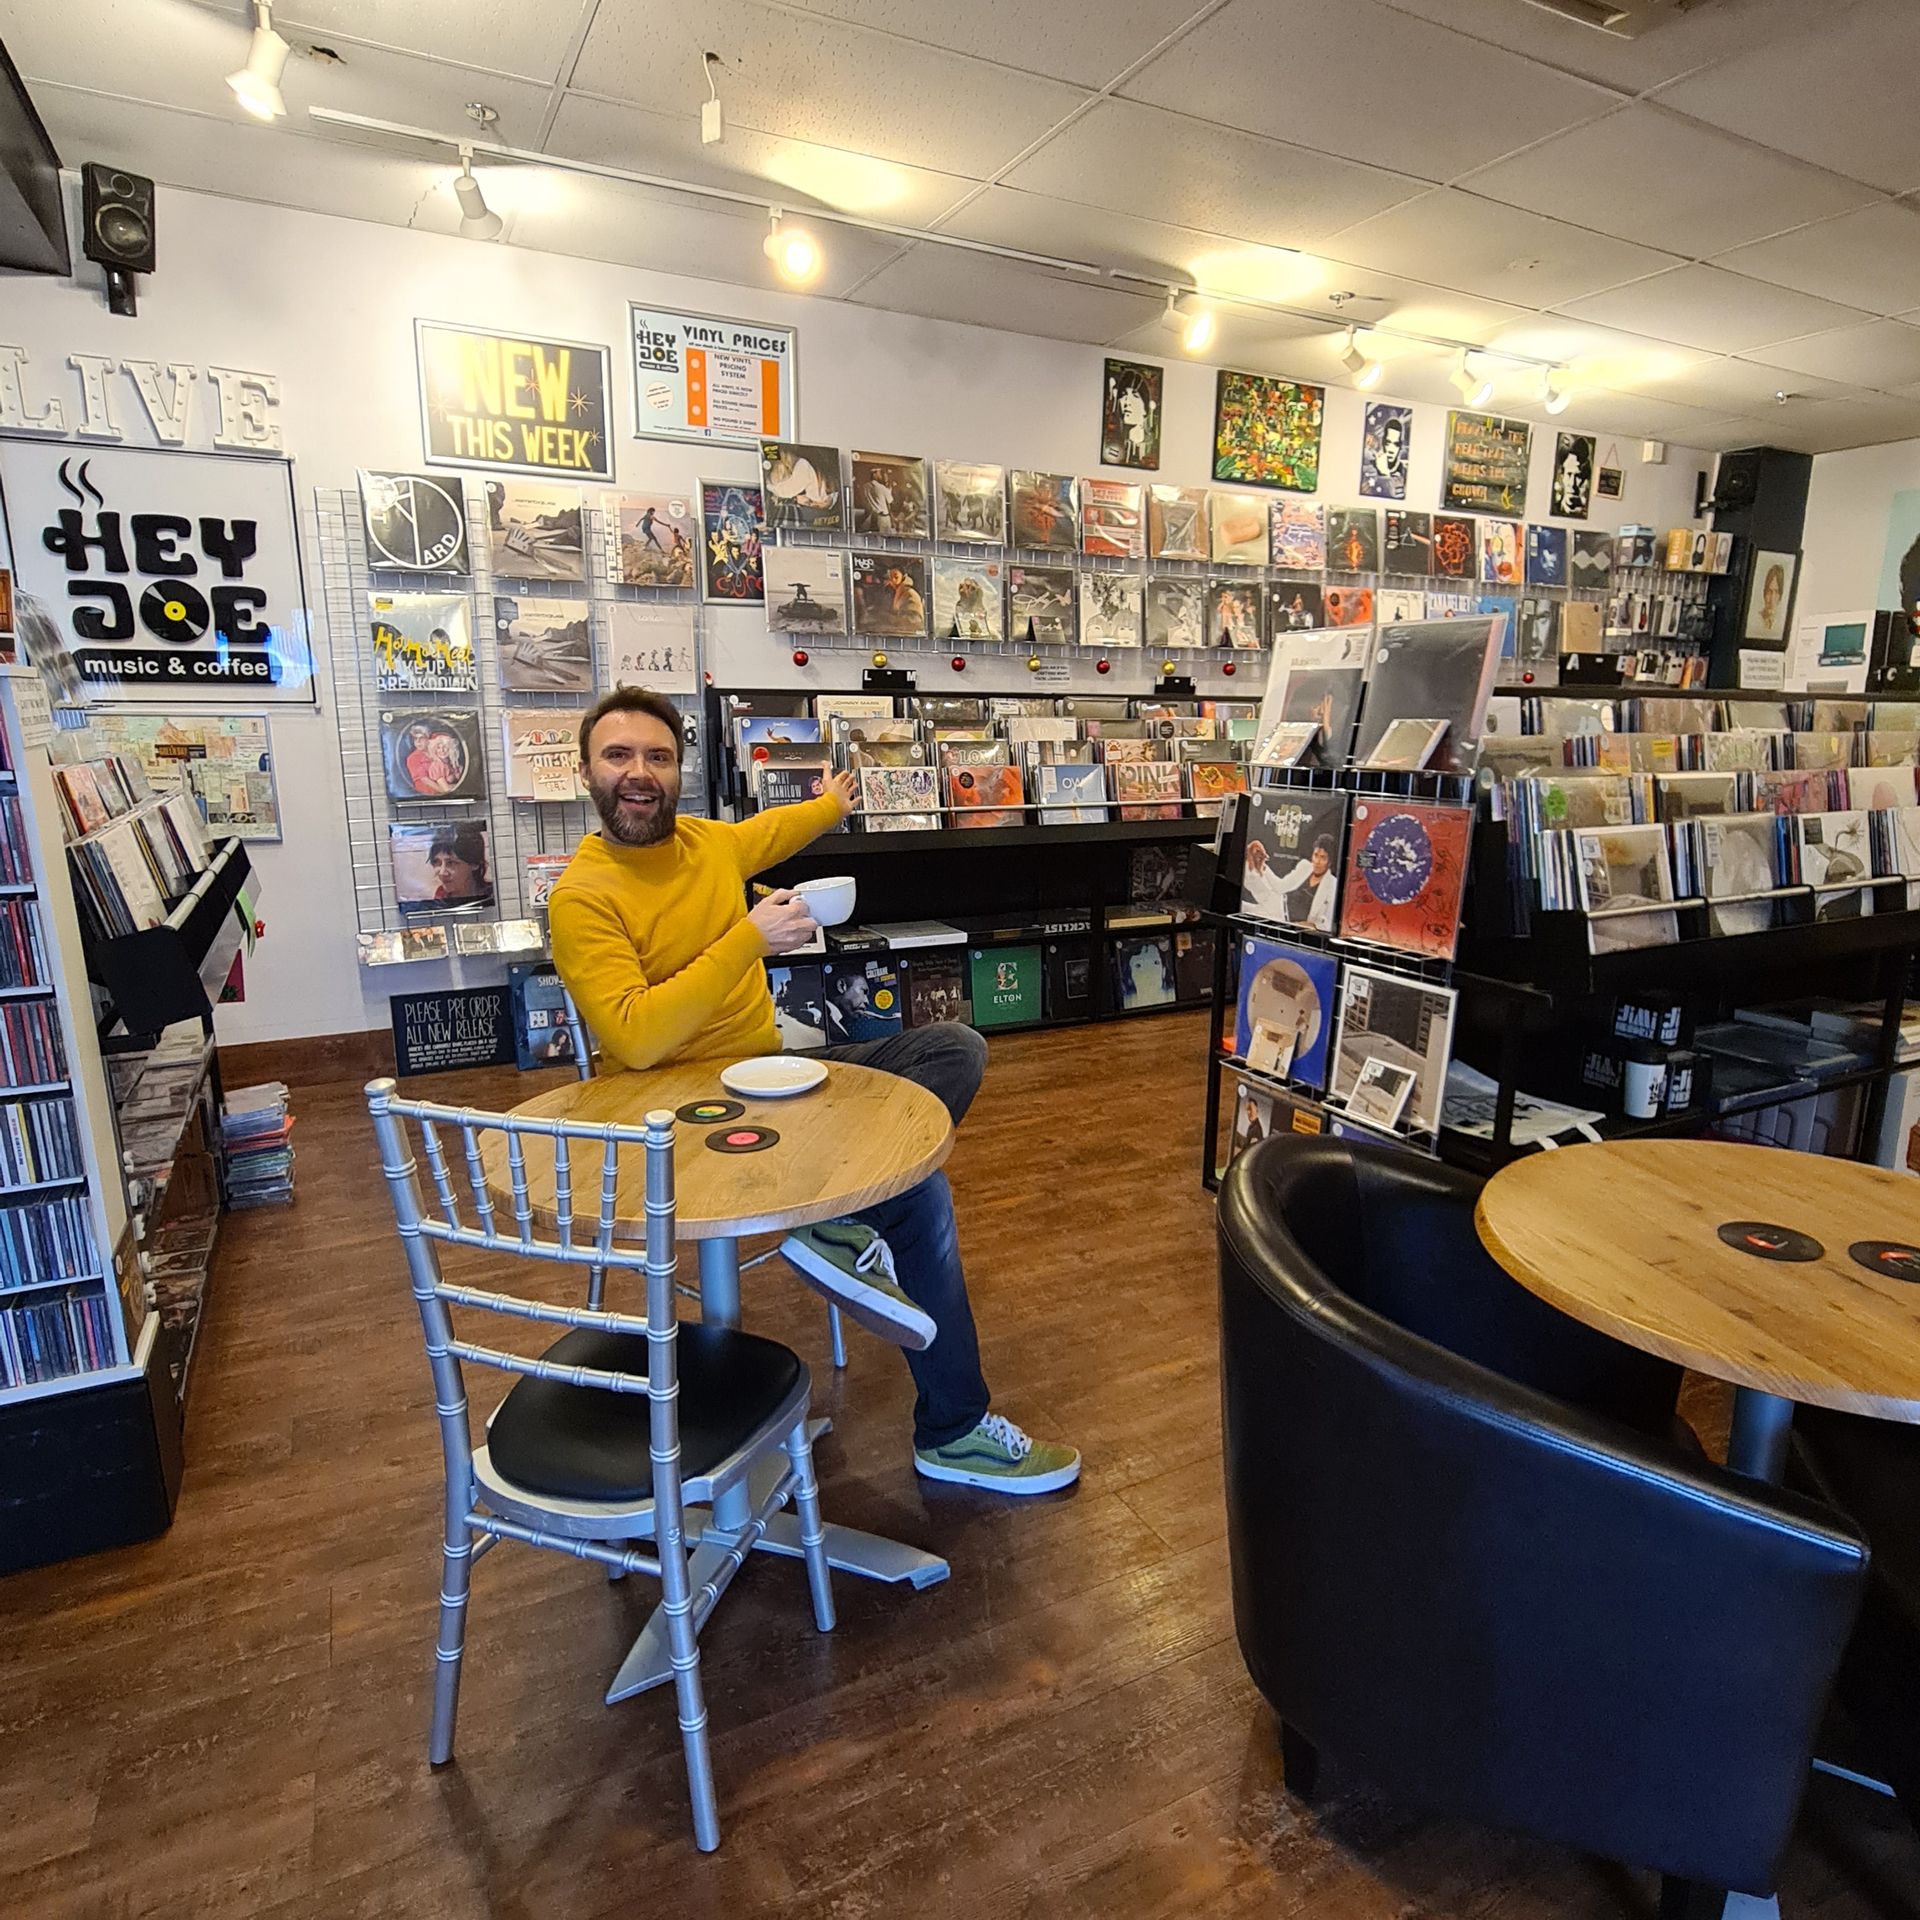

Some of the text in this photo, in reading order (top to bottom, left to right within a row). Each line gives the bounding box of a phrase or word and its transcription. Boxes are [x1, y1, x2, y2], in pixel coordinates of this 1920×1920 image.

[636, 330, 676, 348] HEY
[682, 325, 724, 344] VINYL
[733, 333, 786, 353] PRICES
[640, 346, 678, 364] JOE
[459, 334, 571, 424] NEW
[0, 345, 284, 455] LIVE
[447, 415, 514, 461] THIS
[521, 423, 593, 470] WEEK
[43, 508, 257, 578] HEY
[68, 579, 273, 643] JOE
[84, 656, 269, 677] music & coffee
[1566, 653, 1579, 670] A
[376, 676, 479, 691] BREAKDOWN
[864, 670, 872, 681] L
[906, 671, 916, 681] M
[1189, 677, 1198, 687] R
[959, 750, 1005, 765] LOVE
[768, 784, 802, 798] MANILOW
[404, 995, 502, 1024] PLEASE PRE ORDER
[993, 994, 1022, 1004] ELTON
[406, 1024, 424, 1045] ALL
[428, 1021, 452, 1043] NEW
